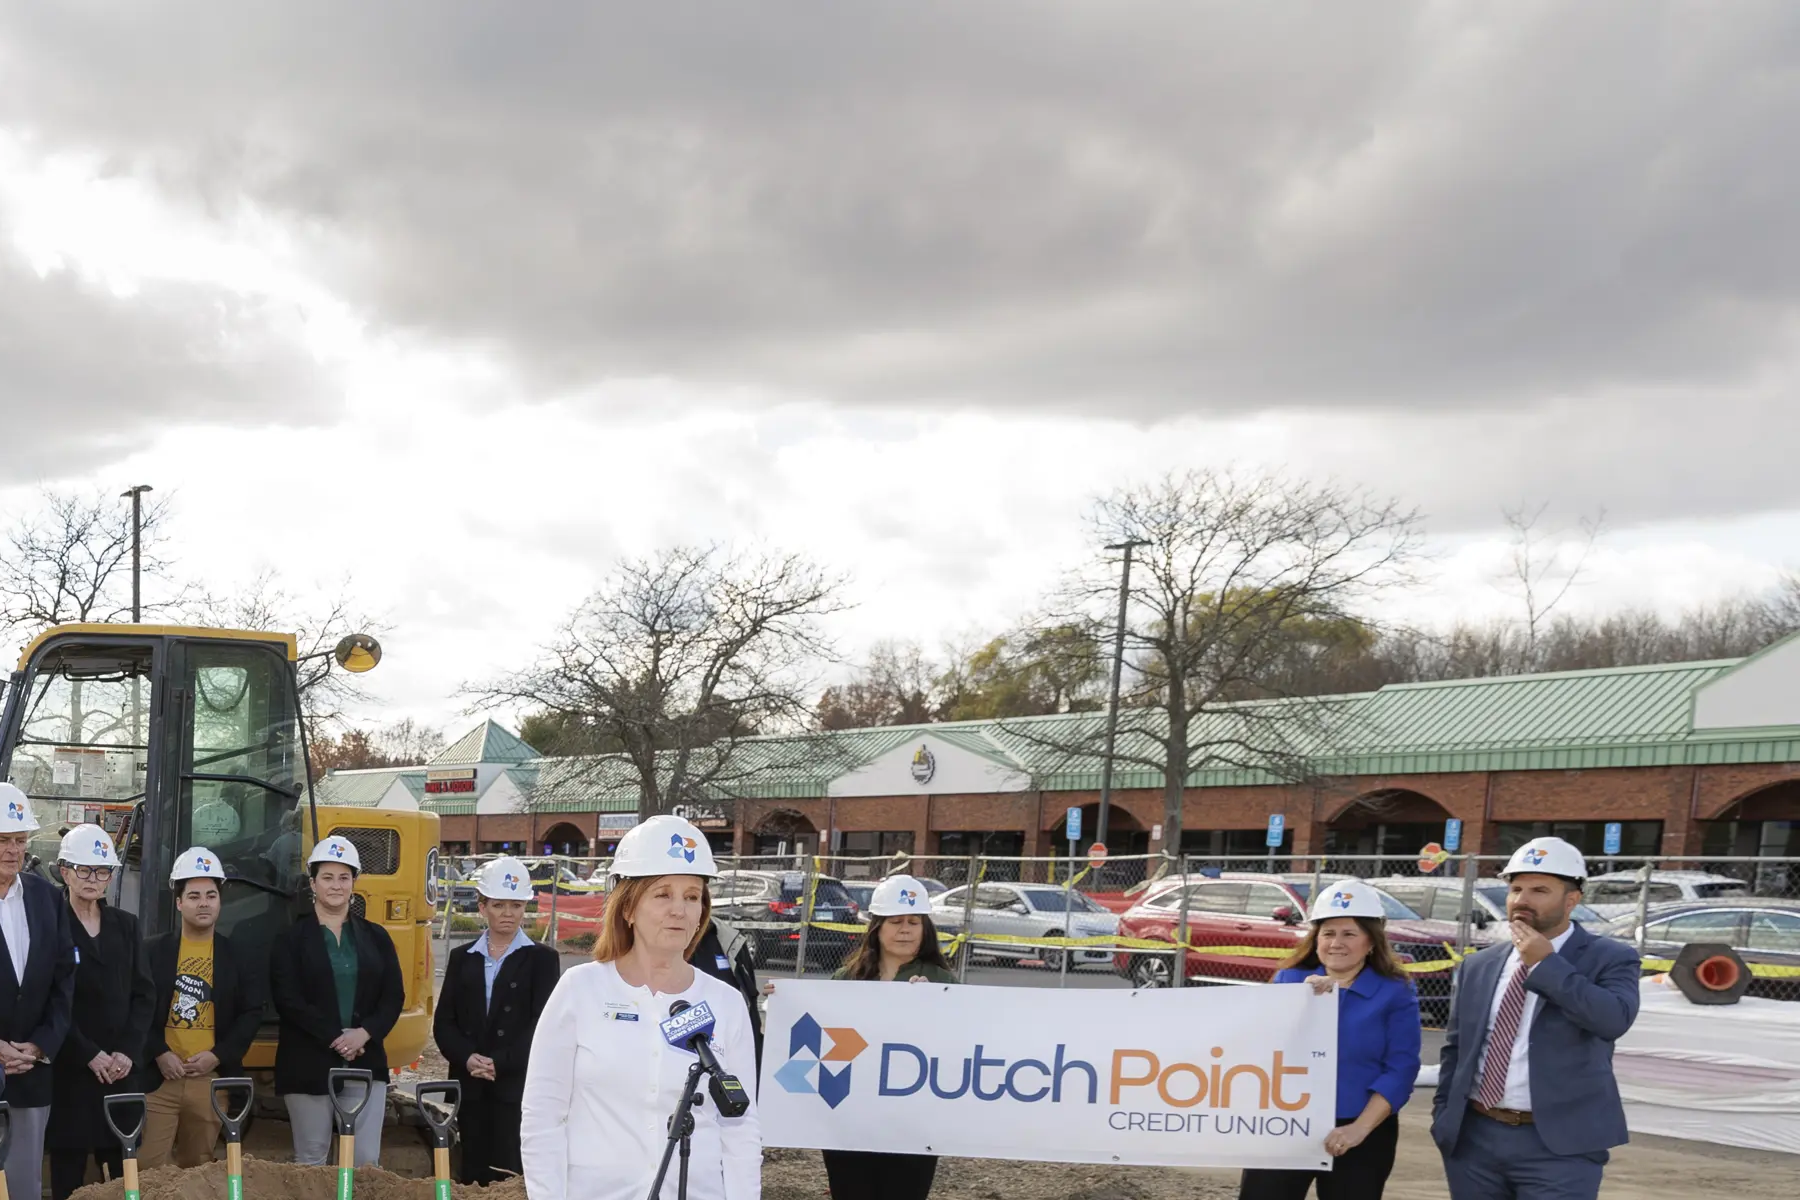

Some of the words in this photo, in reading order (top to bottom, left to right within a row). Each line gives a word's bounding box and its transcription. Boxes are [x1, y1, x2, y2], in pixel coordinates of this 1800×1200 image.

[669, 1029, 688, 1041] NEWS
[687, 1017, 713, 1032] STATION
[878, 1043, 1098, 1104] Dutch
[1109, 1046, 1311, 1112] Point
[1108, 1111, 1209, 1133] CREDIT
[1215, 1115, 1310, 1137] UNION
